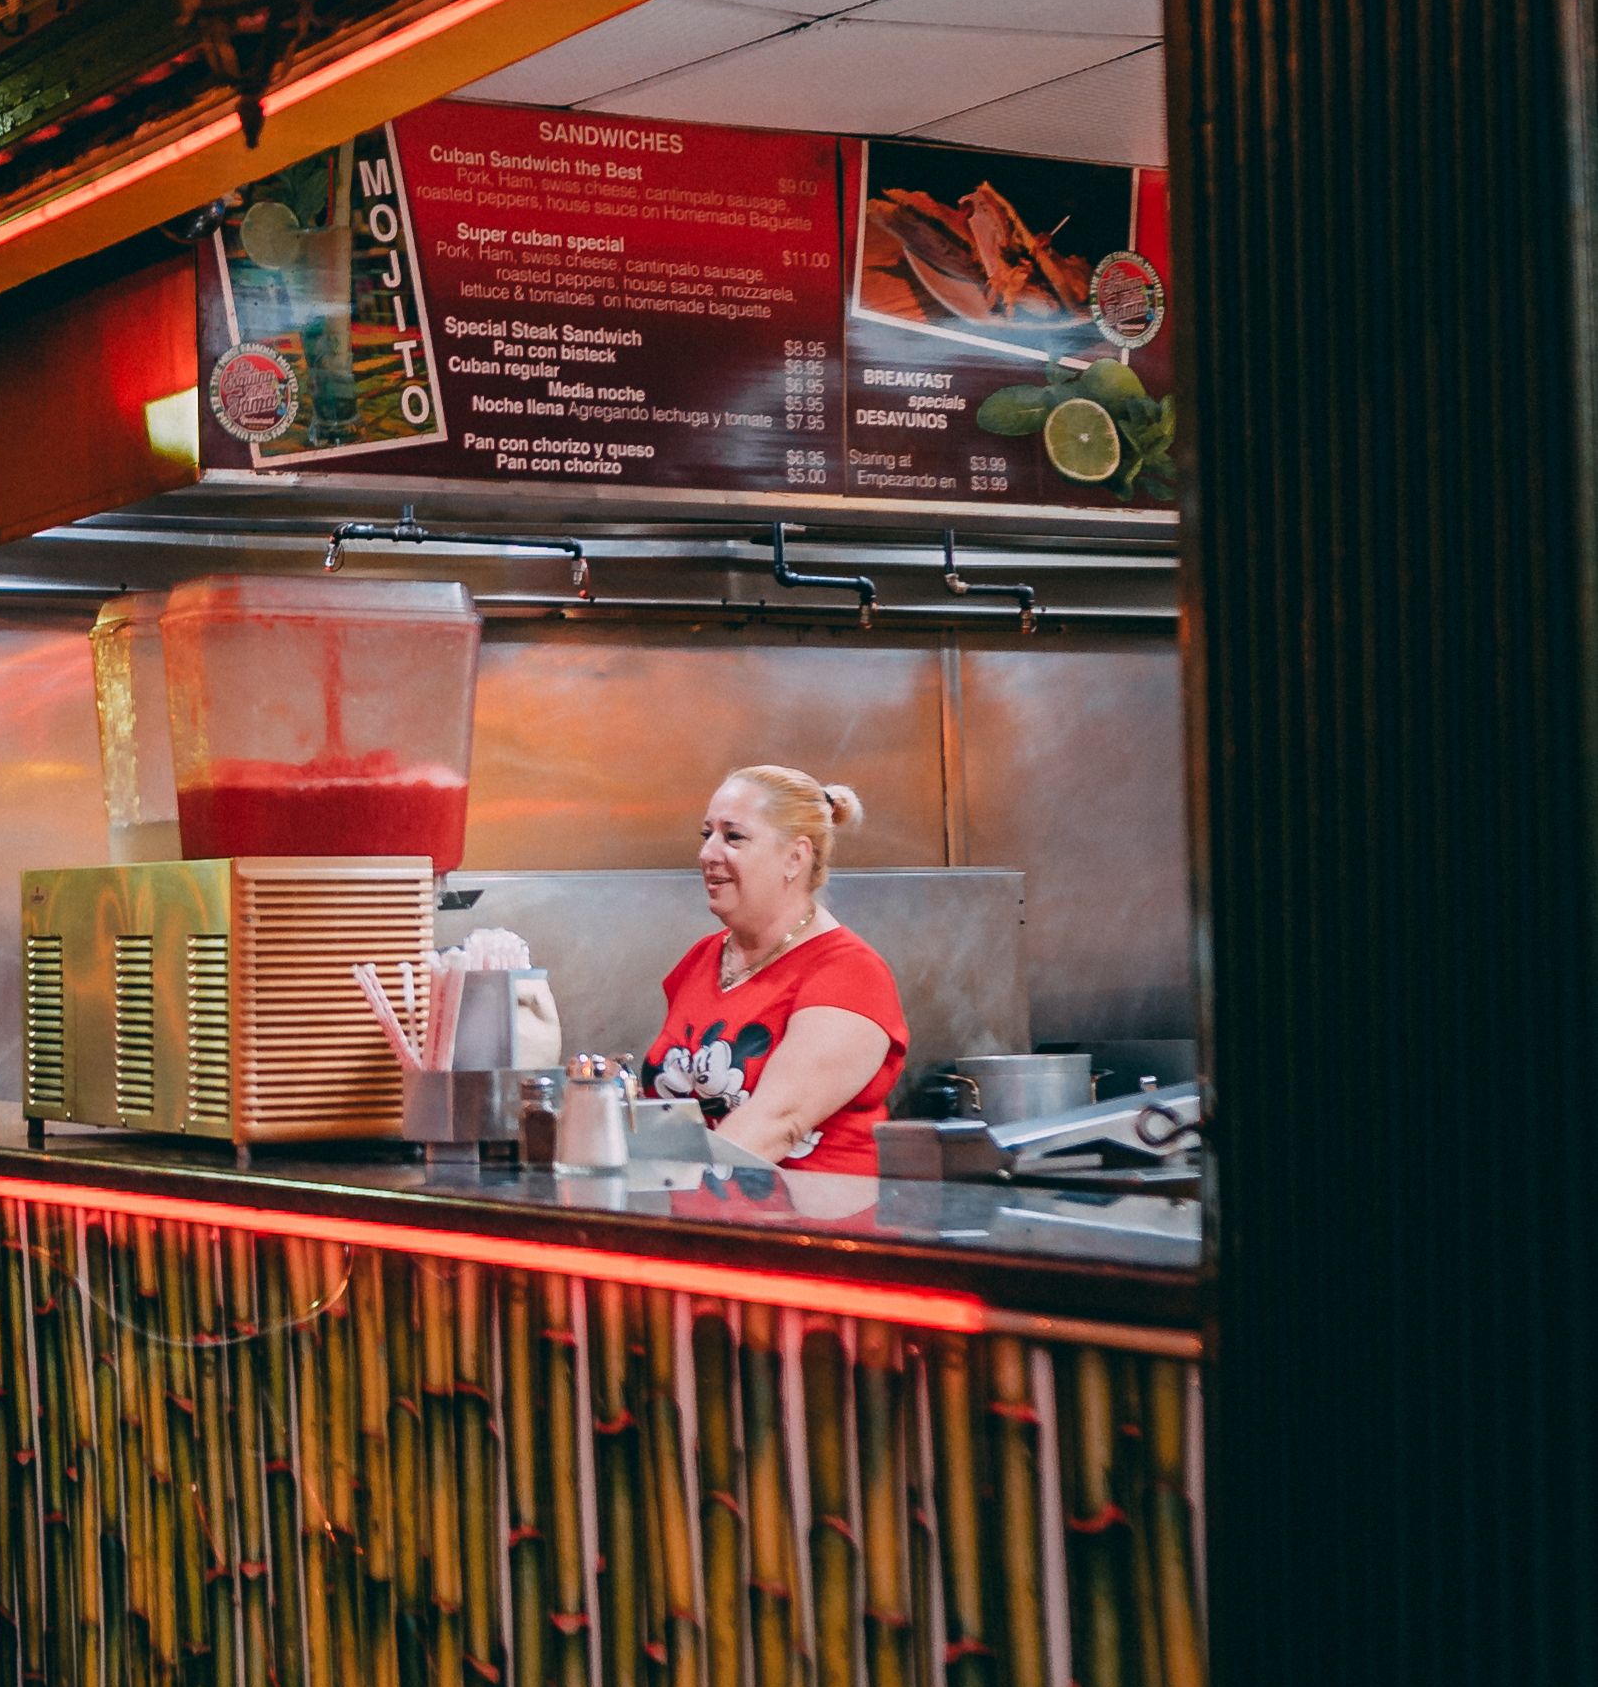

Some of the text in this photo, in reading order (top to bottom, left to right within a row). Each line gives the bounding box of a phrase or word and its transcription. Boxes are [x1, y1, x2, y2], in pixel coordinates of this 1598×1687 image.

[539, 120, 684, 155] SANDWICHES
[430, 144, 643, 181] Cuban Sandwich the Best
[457, 166, 494, 187] Pork,
[498, 171, 538, 191] Ham,
[542, 177, 581, 194] swiss
[584, 178, 641, 201] cheese,
[727, 192, 791, 215] sausage,
[777, 177, 818, 197] $9.00
[416, 183, 813, 233] roasted peppers, house sauce on Homemade Baguette
[456, 221, 625, 253] Super cuban special
[436, 240, 474, 261] Pork,
[478, 243, 518, 265] Ham,
[521, 250, 562, 267] swiss
[564, 253, 622, 273] cheese,
[703, 264, 768, 284] sausage,
[781, 249, 831, 270] $11.00
[358, 157, 431, 425] MOJITO
[495, 267, 552, 285] roasted
[554, 271, 620, 292] peppers,
[623, 274, 668, 294] house
[670, 280, 718, 299] sauce,
[460, 280, 773, 321] lettuce & tomatoes on homemade baguette
[444, 314, 643, 348] Special Steak Sandwich
[493, 339, 617, 364] Pan con bisteck
[783, 338, 827, 359] $8.95
[448, 355, 561, 382] Cuban regular
[862, 368, 954, 390] BREAKFAST
[548, 380, 646, 403] Media noche
[784, 393, 825, 413] $5.95
[908, 393, 967, 411] specials
[472, 394, 774, 429] Noche llena Agregando lechuga y tomate
[785, 413, 826, 432] $7.95
[855, 408, 949, 430] DESAYUNOS
[464, 432, 656, 461] Pan con chorizo y queso
[496, 452, 624, 476] Pan con chorizo
[899, 452, 912, 468] at
[969, 455, 1007, 473] $3.99
[787, 466, 828, 485] $5.00
[857, 469, 957, 489] Empezando en
[970, 474, 1008, 492] $3.99
